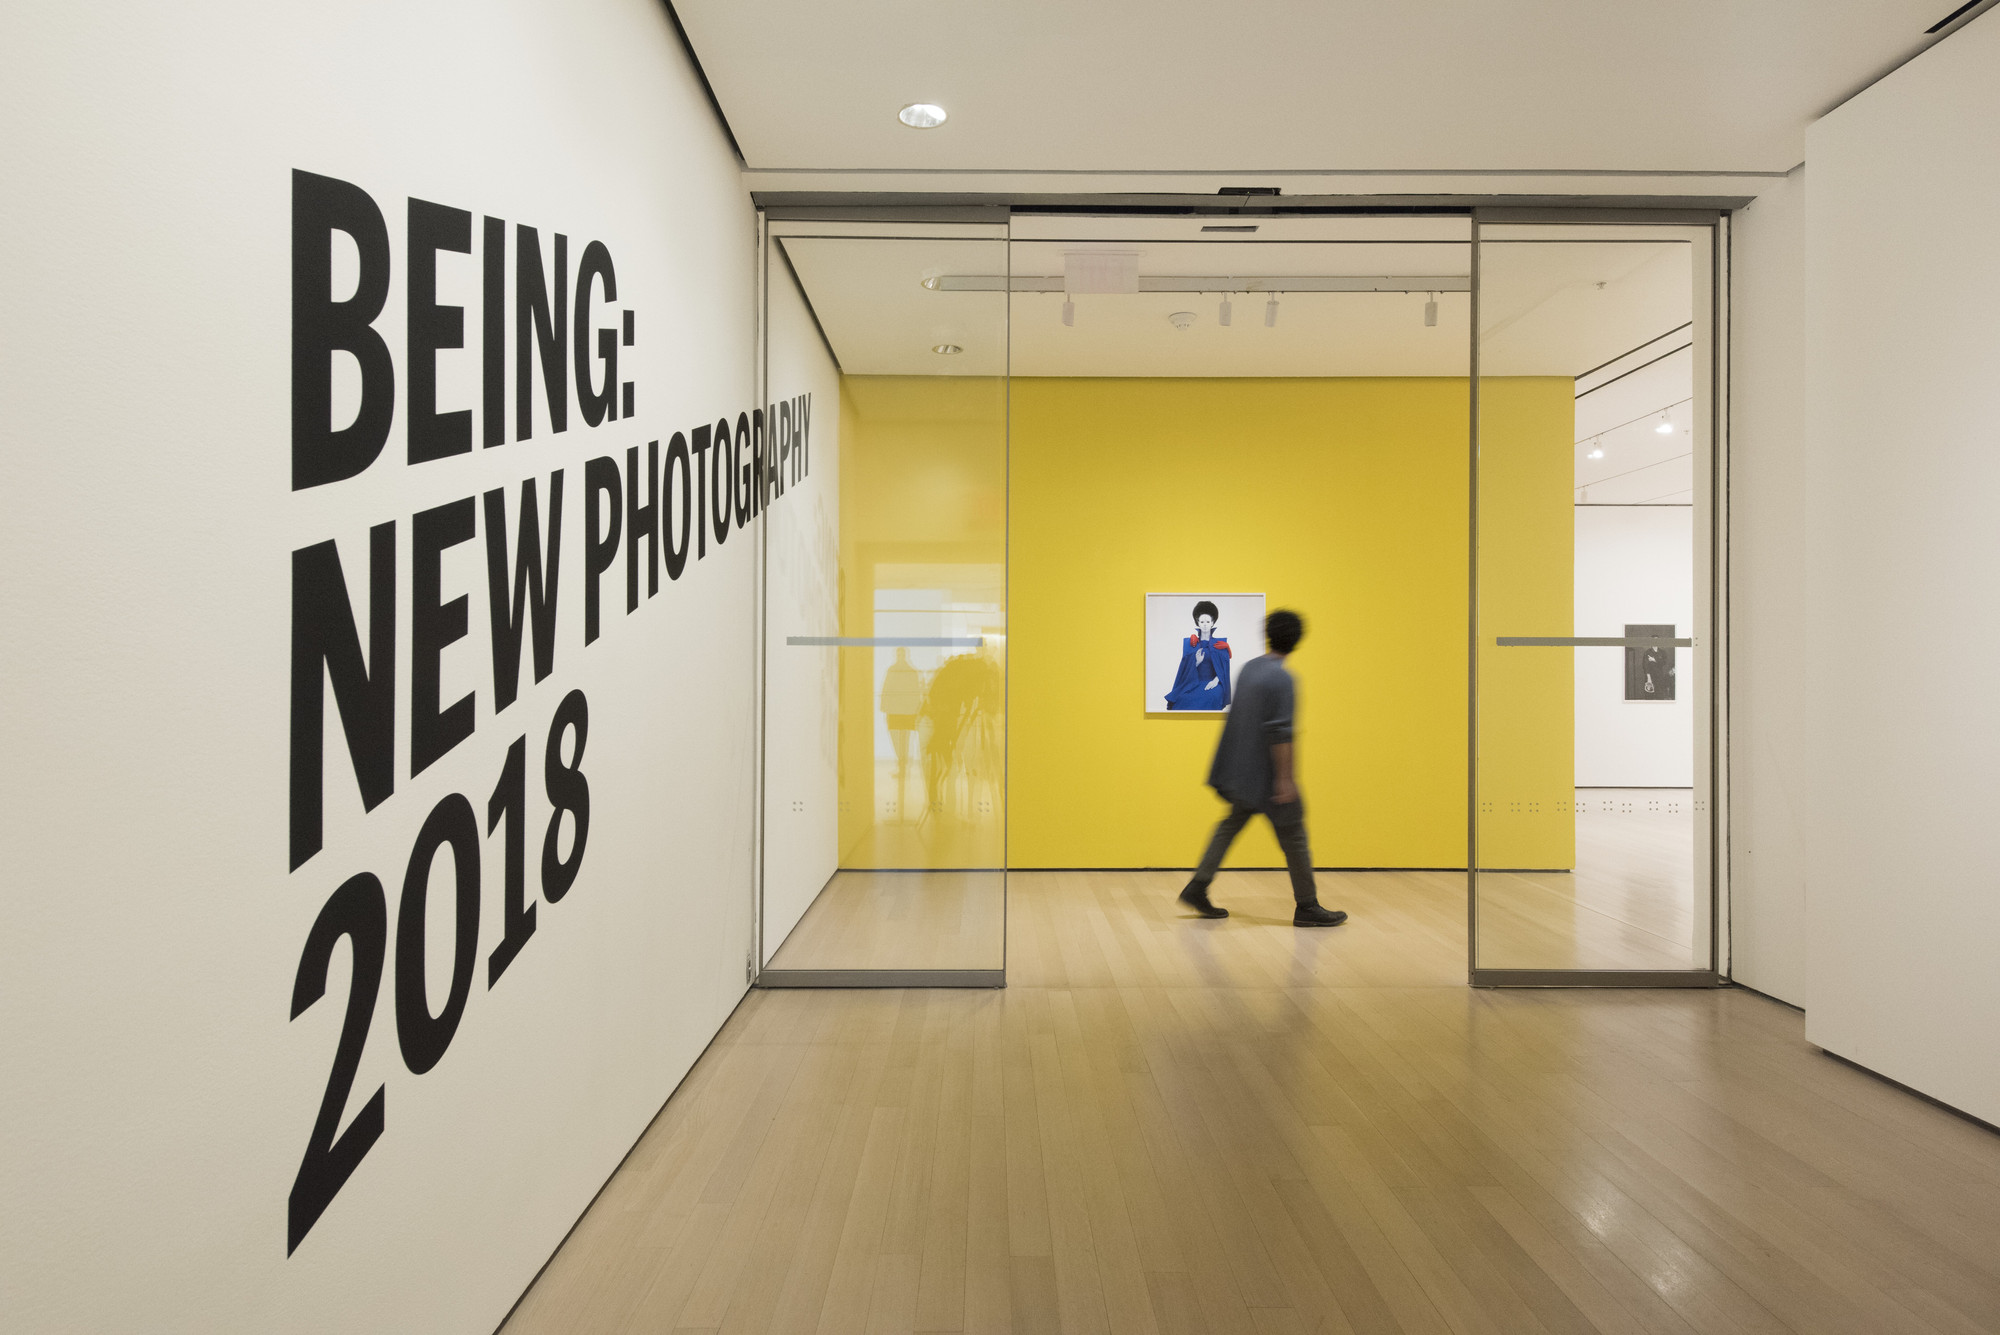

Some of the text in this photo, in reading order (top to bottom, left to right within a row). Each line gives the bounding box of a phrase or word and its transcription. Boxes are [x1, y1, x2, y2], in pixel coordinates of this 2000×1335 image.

[292, 169, 634, 491] BEING:
[290, 393, 811, 873] NEW PHOTOGRAPHY
[288, 689, 590, 1258] 2018
